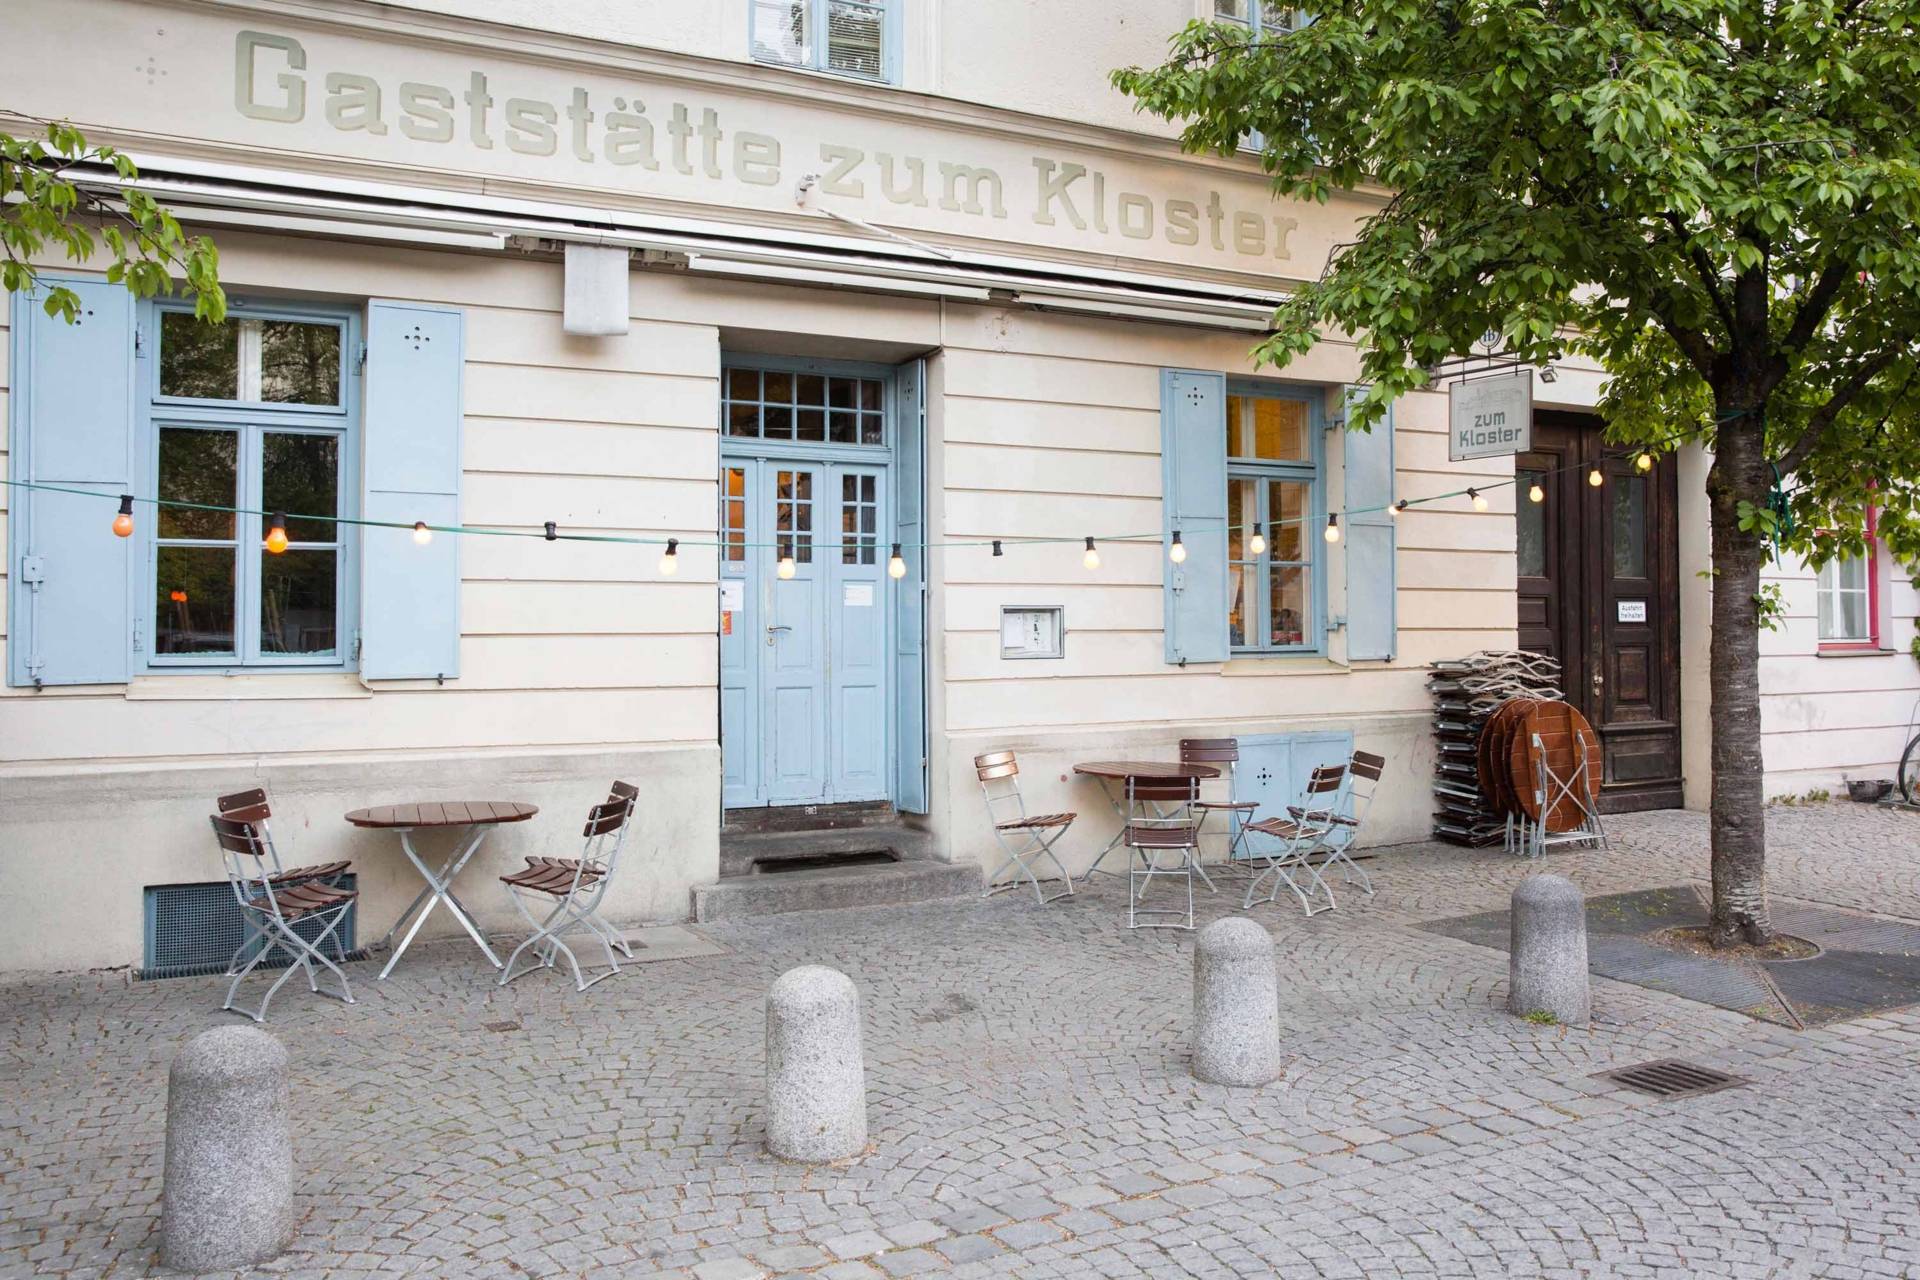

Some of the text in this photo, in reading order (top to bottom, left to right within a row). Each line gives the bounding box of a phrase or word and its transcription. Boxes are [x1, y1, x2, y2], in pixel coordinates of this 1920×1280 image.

[235, 29, 1299, 260] Gaststätte zum Kloster
[1474, 411, 1506, 428] zum
[1459, 428, 1523, 448] Kloster
